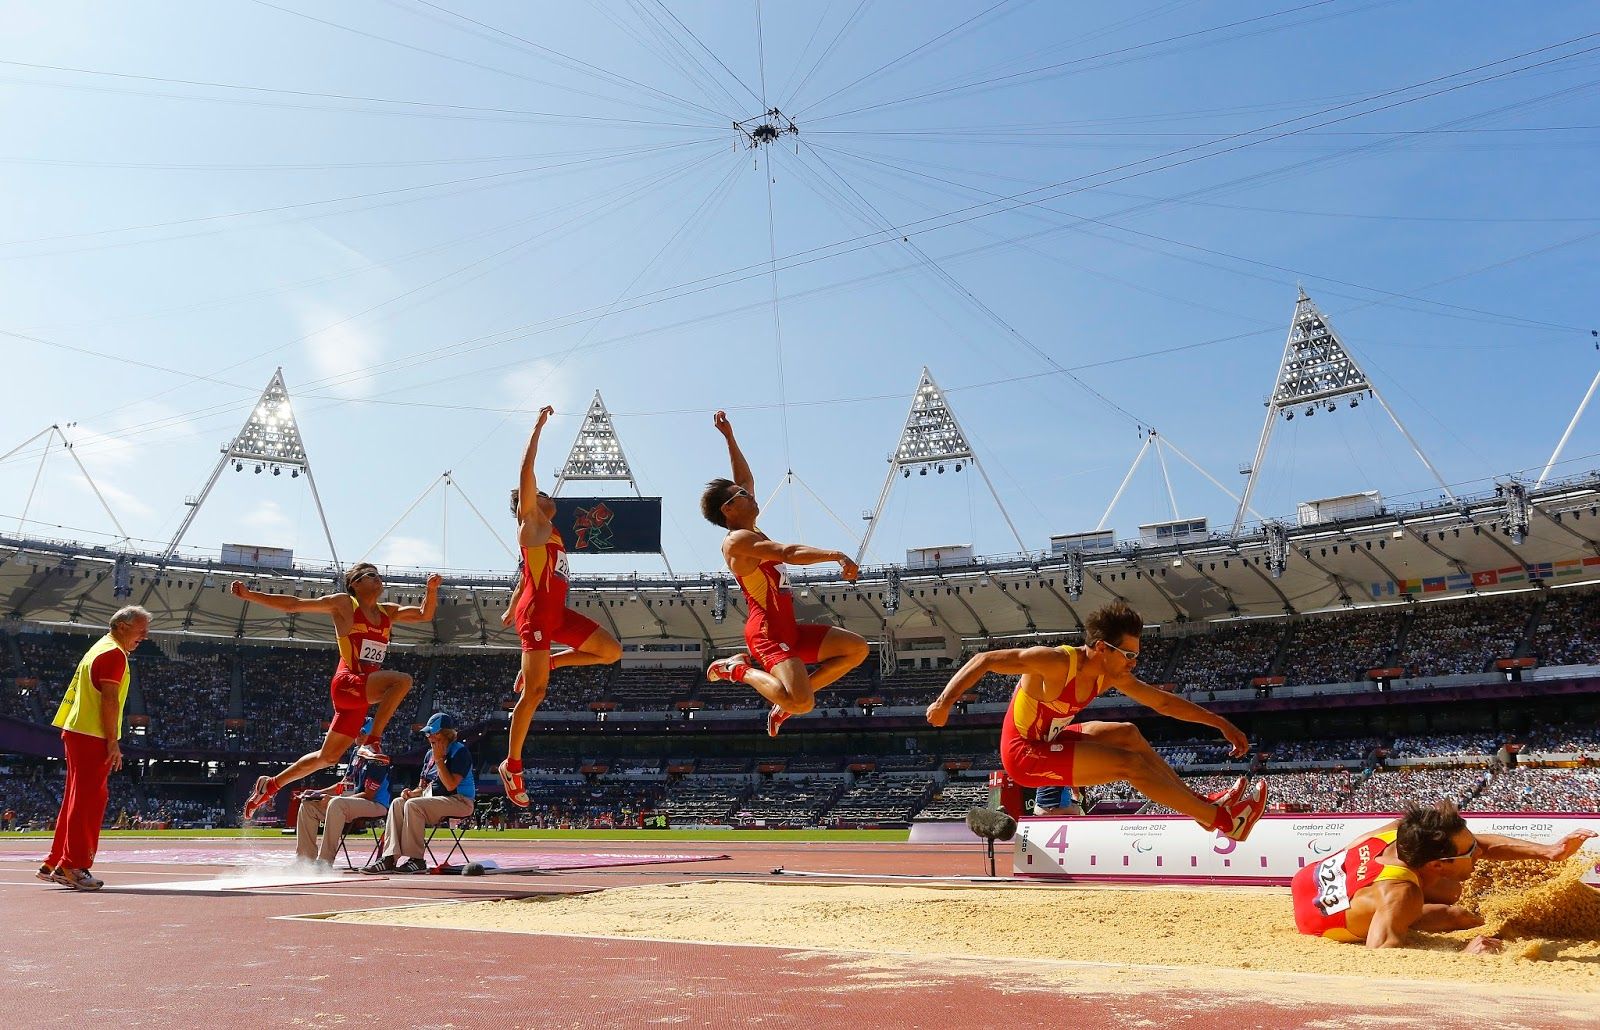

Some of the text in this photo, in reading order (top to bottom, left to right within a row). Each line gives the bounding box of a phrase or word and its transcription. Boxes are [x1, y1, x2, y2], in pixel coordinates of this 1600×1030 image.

[1045, 825, 1069, 853] 4
[1492, 823, 1553, 831] London 2012
[1213, 829, 1237, 855] 5
[1320, 859, 1340, 908] 2263
